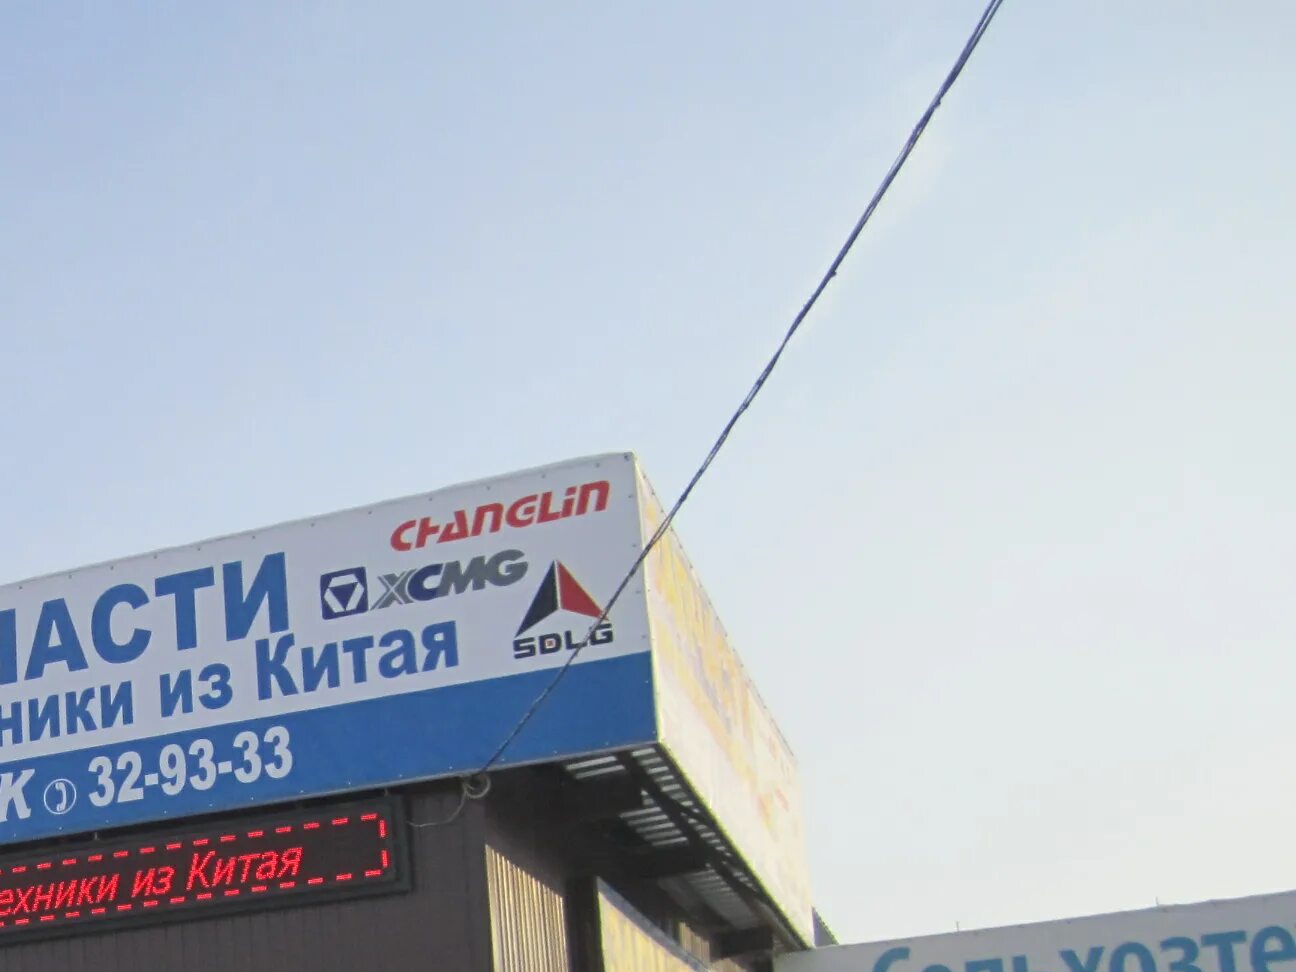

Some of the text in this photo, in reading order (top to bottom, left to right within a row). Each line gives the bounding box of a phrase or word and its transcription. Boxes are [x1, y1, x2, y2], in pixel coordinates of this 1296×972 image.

[370, 549, 528, 610] XCMG
[160, 663, 232, 718] из
[255, 619, 459, 700] Китая
[513, 622, 614, 659] SDLG
[88, 726, 293, 807] 32-93-33
[132, 866, 175, 897] из
[186, 847, 303, 892] Китая
